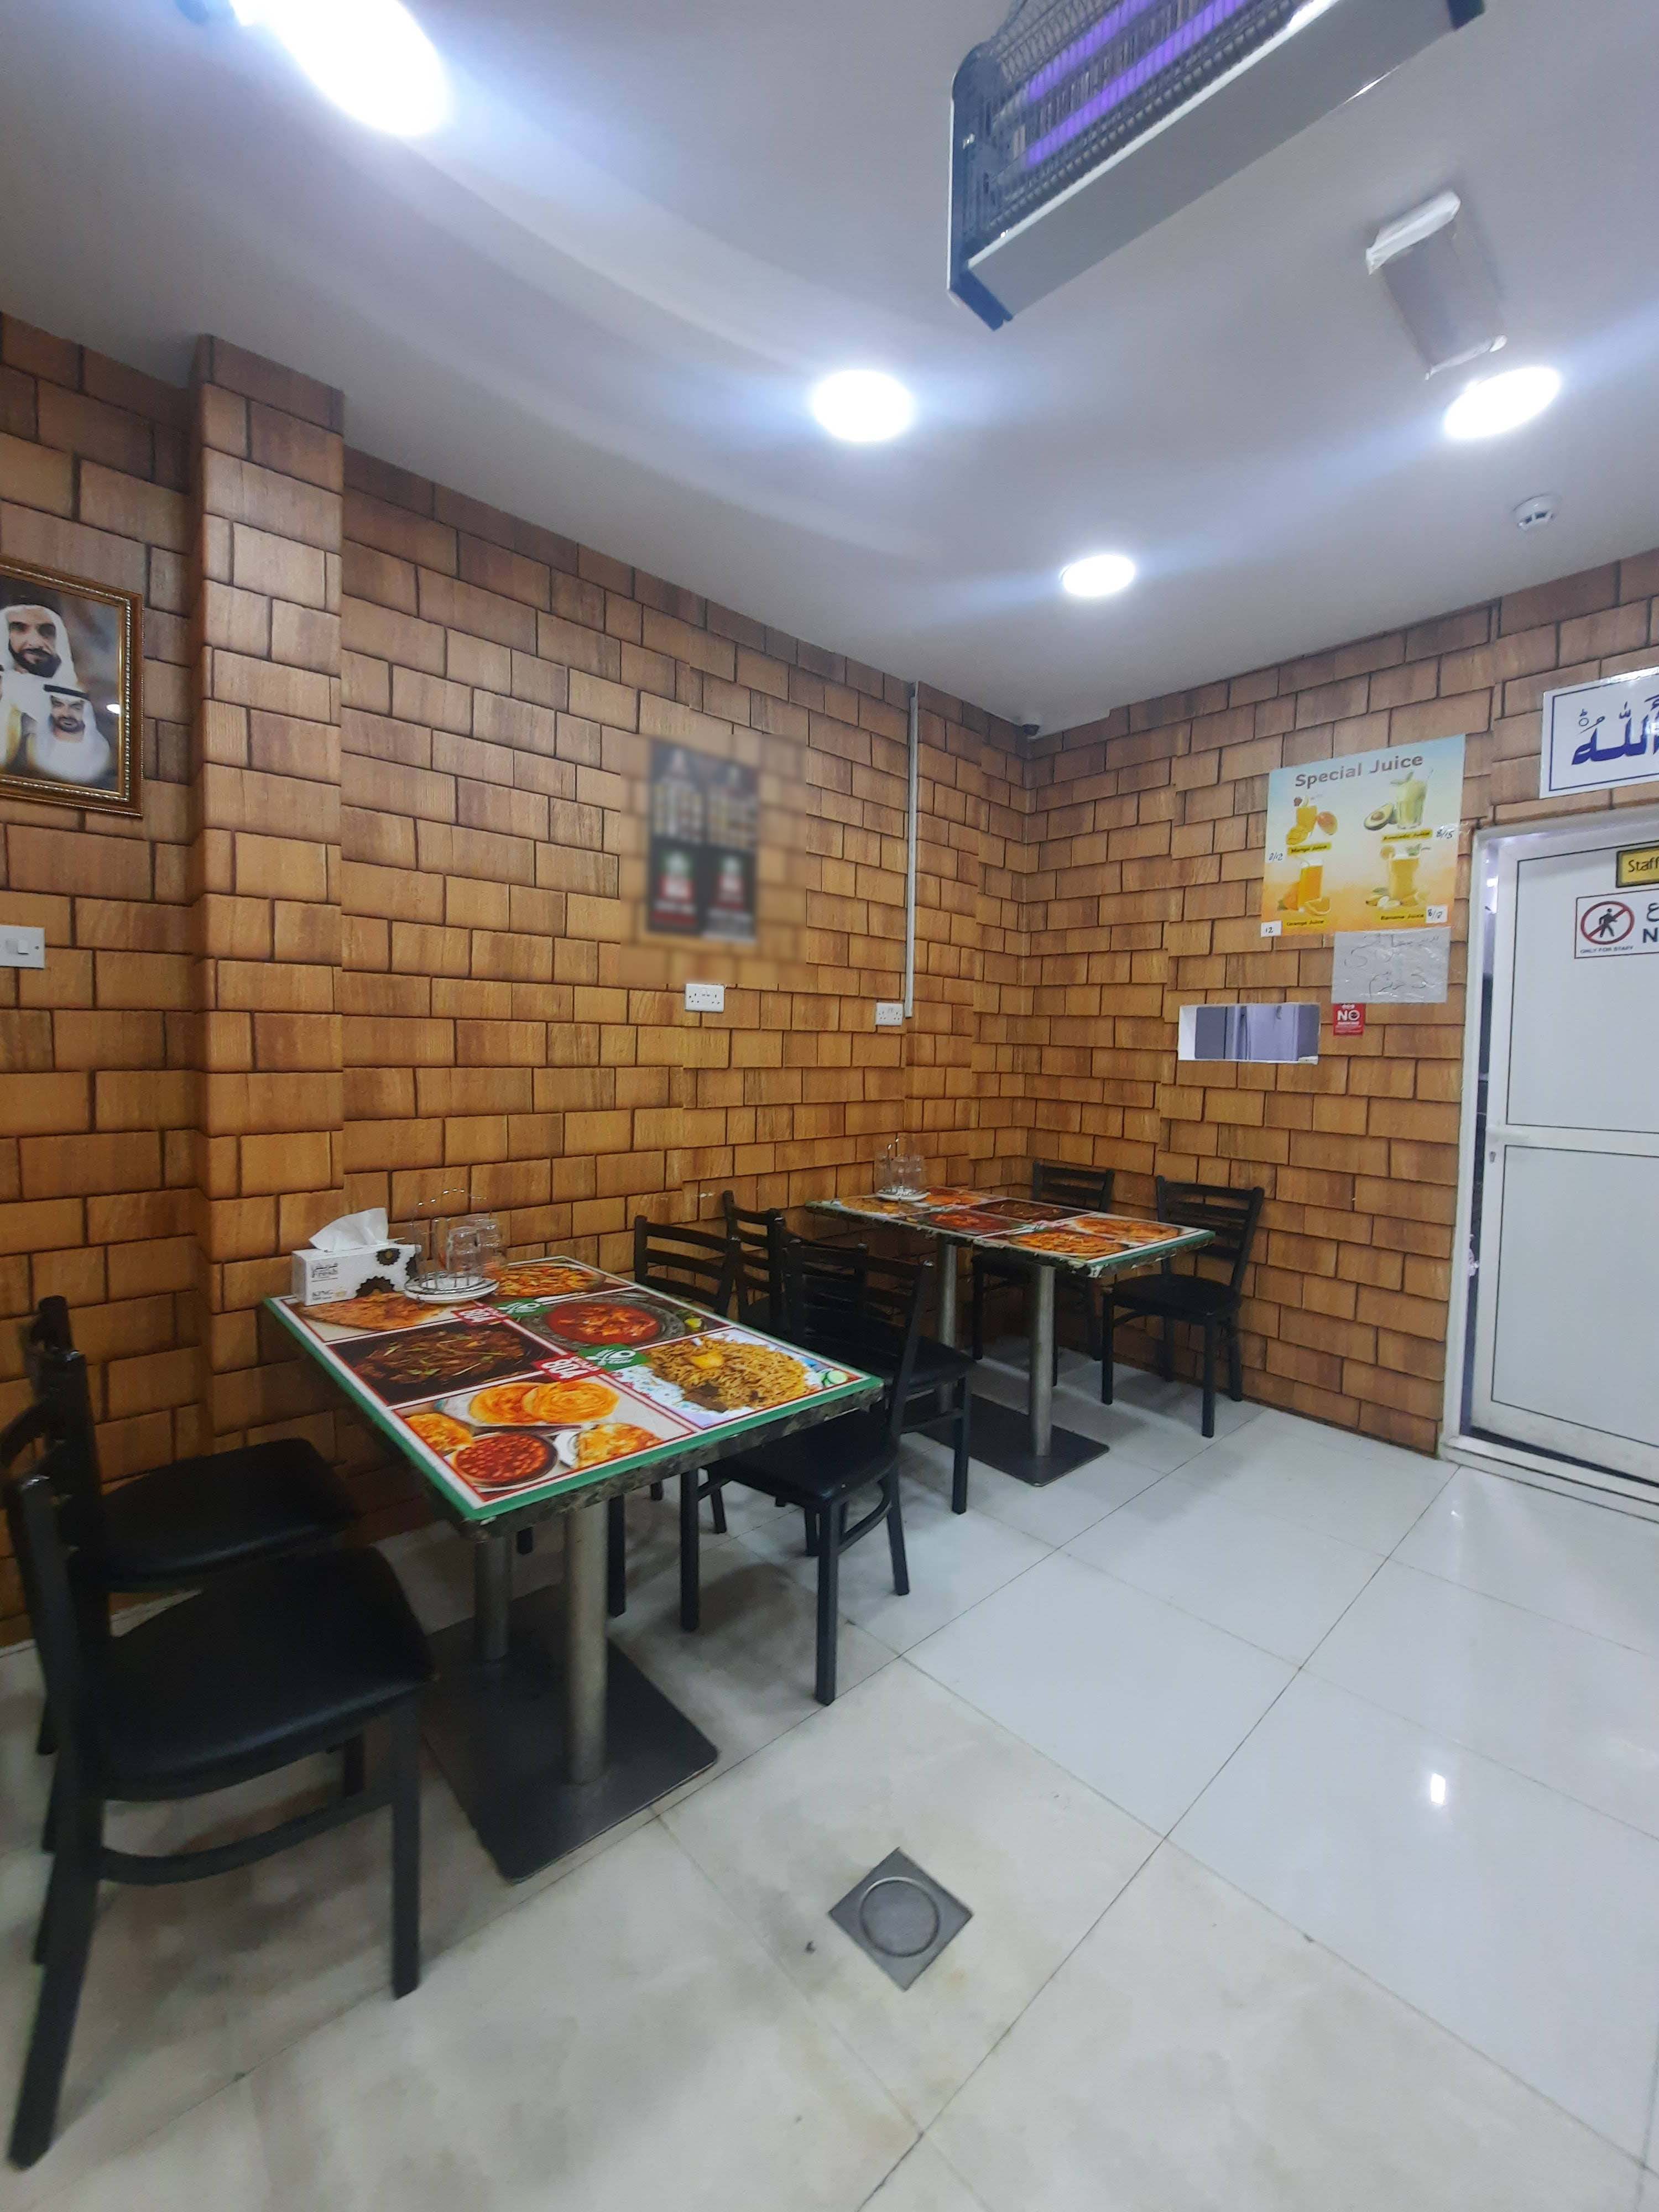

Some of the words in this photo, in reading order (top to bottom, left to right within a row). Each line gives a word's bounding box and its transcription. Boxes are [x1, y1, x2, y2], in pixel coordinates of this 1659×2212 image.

[1295, 762, 1362, 789] Special
[1370, 755, 1423, 774] Juice
[1337, 1010, 1360, 1021] NO
[540, 1358, 588, 1379] 804
